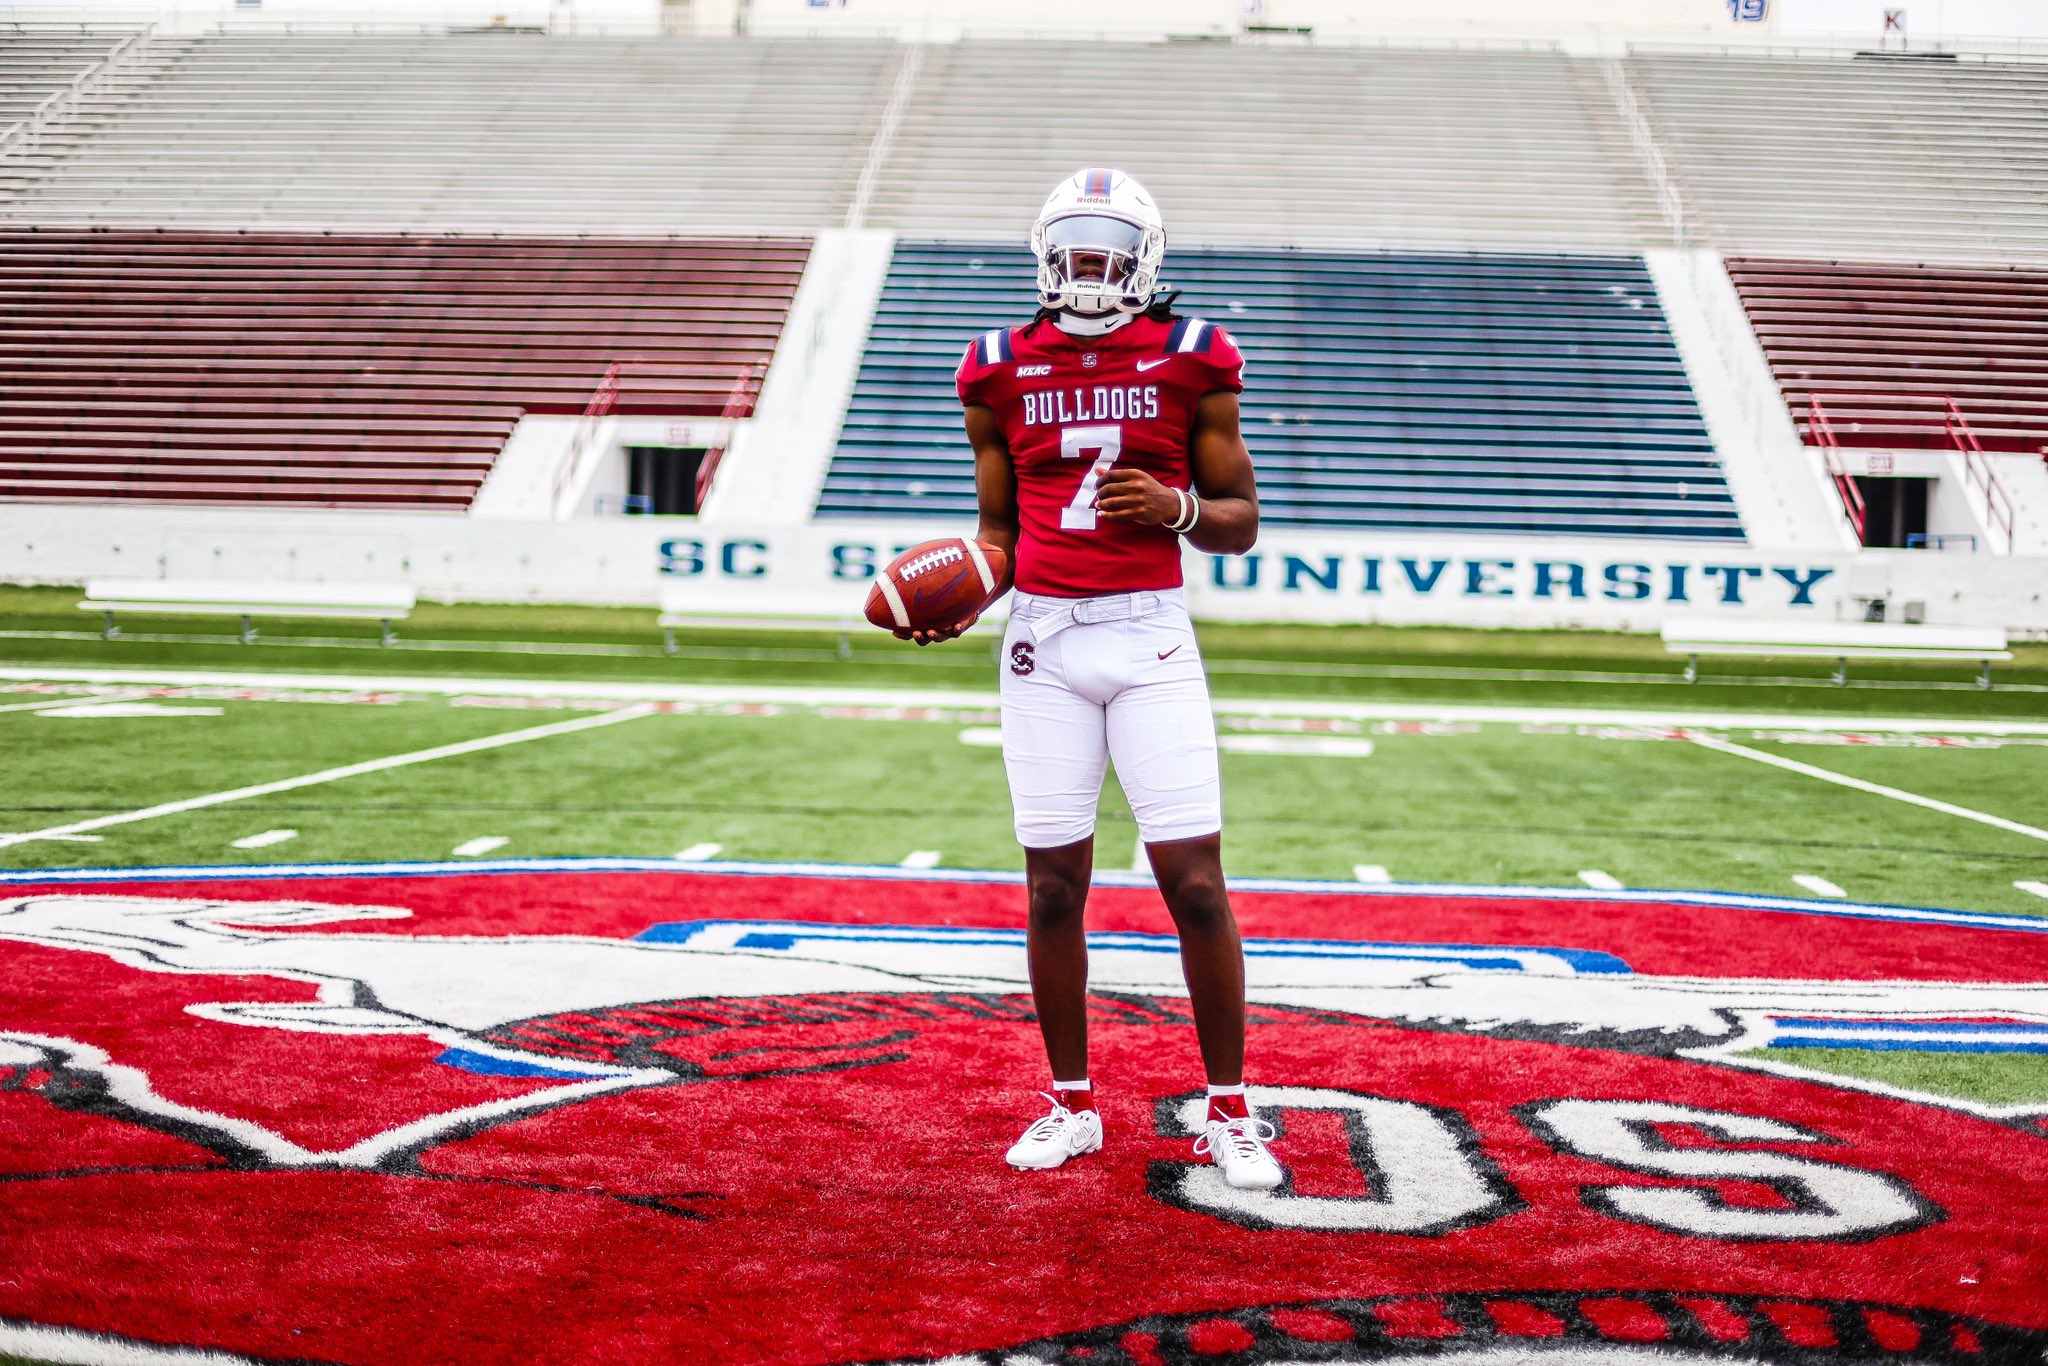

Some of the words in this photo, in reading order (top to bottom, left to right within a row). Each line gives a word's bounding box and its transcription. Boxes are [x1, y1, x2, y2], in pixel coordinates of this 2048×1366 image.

[1884, 10, 1902, 30] K
[1076, 196, 1111, 205] Riddell
[1017, 366, 1051, 377] MEAC
[1023, 386, 1158, 425] BULLDOGS
[1060, 426, 1121, 529] 7
[659, 541, 767, 575] SC
[1211, 554, 1834, 604] UNIVERSITY
